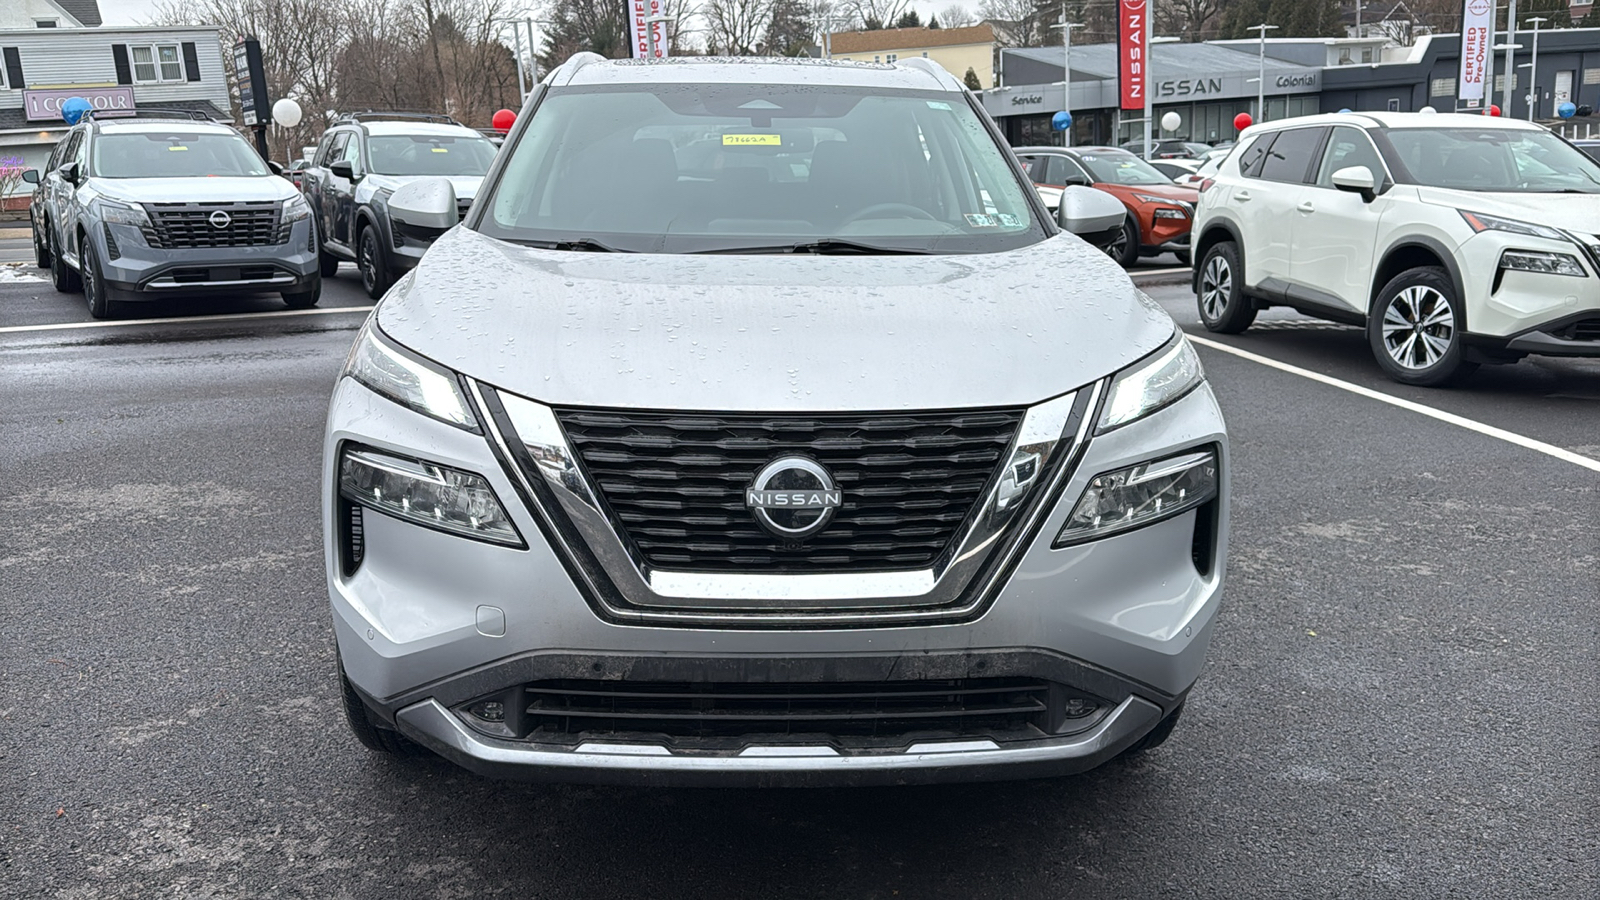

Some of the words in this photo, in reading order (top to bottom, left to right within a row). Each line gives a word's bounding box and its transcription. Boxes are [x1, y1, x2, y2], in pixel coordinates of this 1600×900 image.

[635, 0, 648, 58] ERTIFIE
[1129, 14, 1141, 98] NISSAN
[1465, 27, 1477, 84] CERTIFIED
[1473, 27, 1487, 84] Pre-Owned
[1154, 78, 1222, 97] ISSAN
[1276, 74, 1316, 88] Colonial
[43, 95, 127, 112] COTOUR
[1011, 94, 1043, 106] Service
[749, 492, 839, 505] NISSAN
